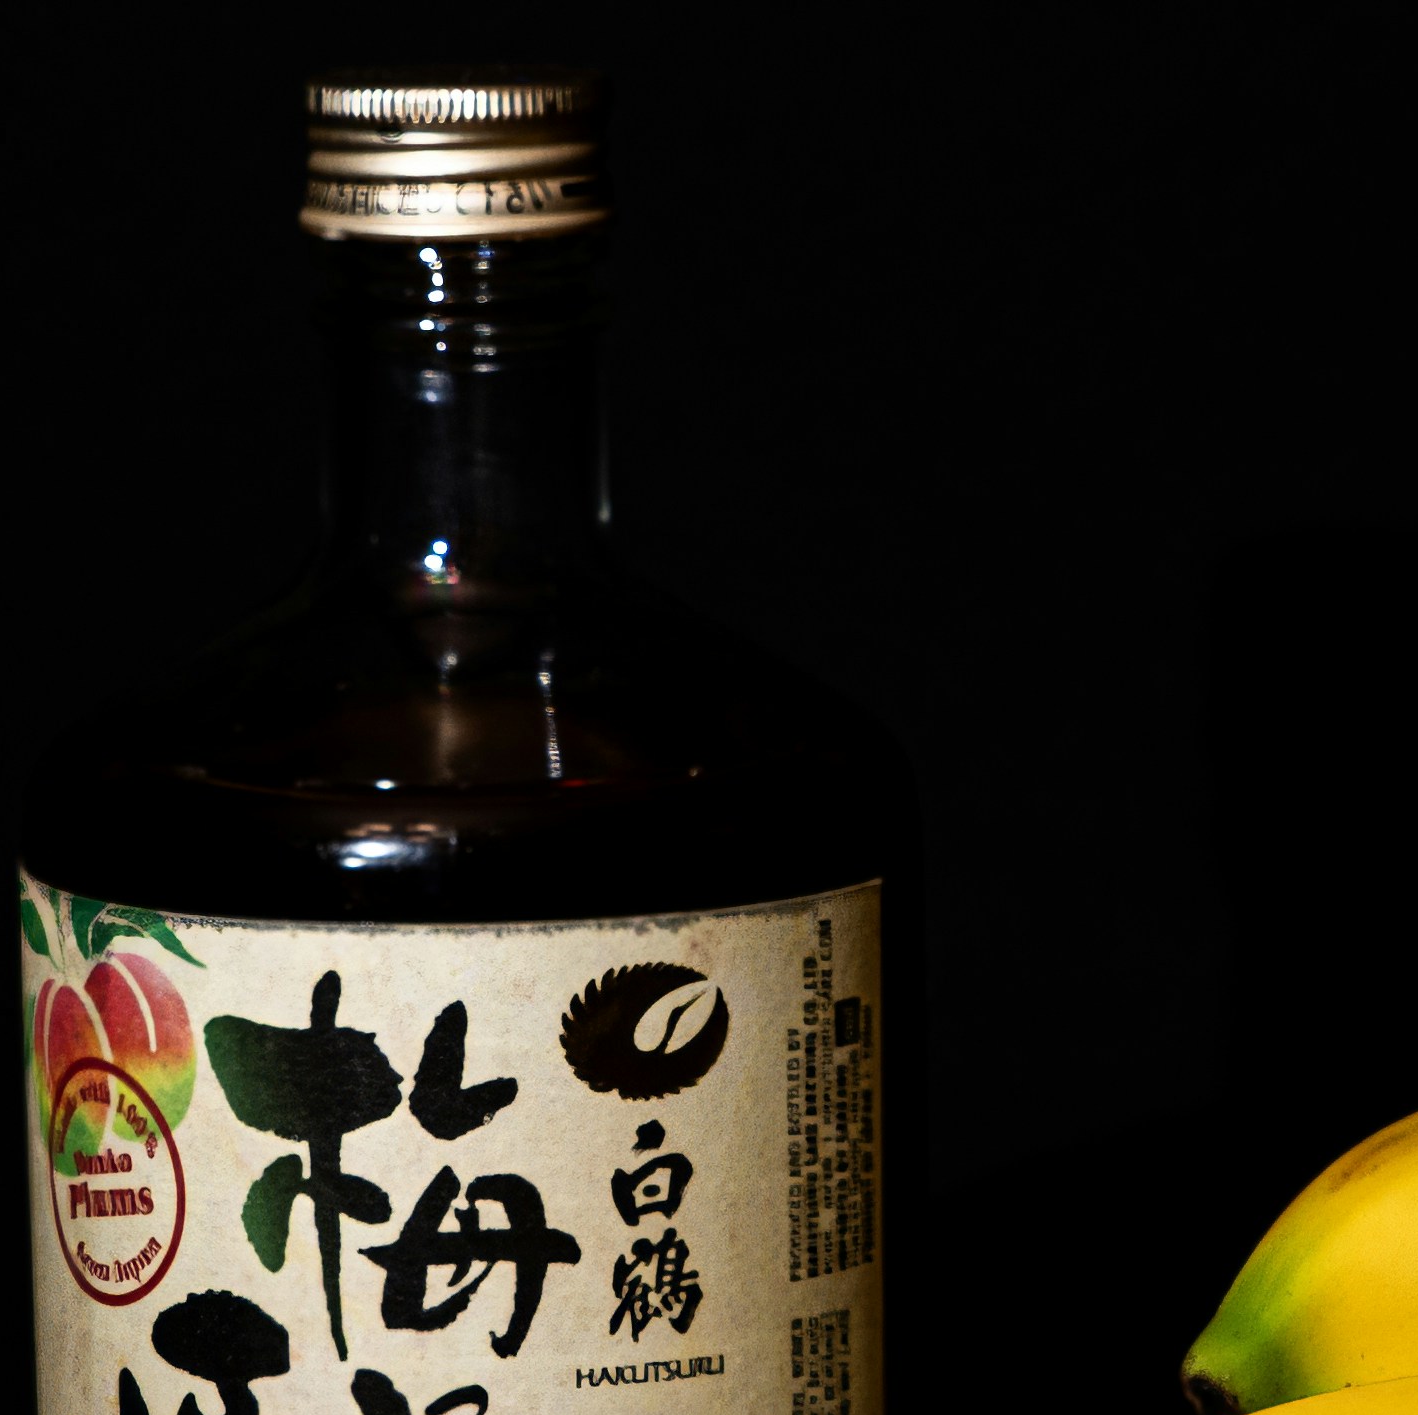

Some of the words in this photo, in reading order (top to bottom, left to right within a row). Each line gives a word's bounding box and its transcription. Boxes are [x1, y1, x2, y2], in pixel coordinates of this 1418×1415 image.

[68, 1181, 155, 1220] Plums
[609, 1119, 704, 1343] 白鶴
[576, 1354, 725, 1388] HAKUTSURU
